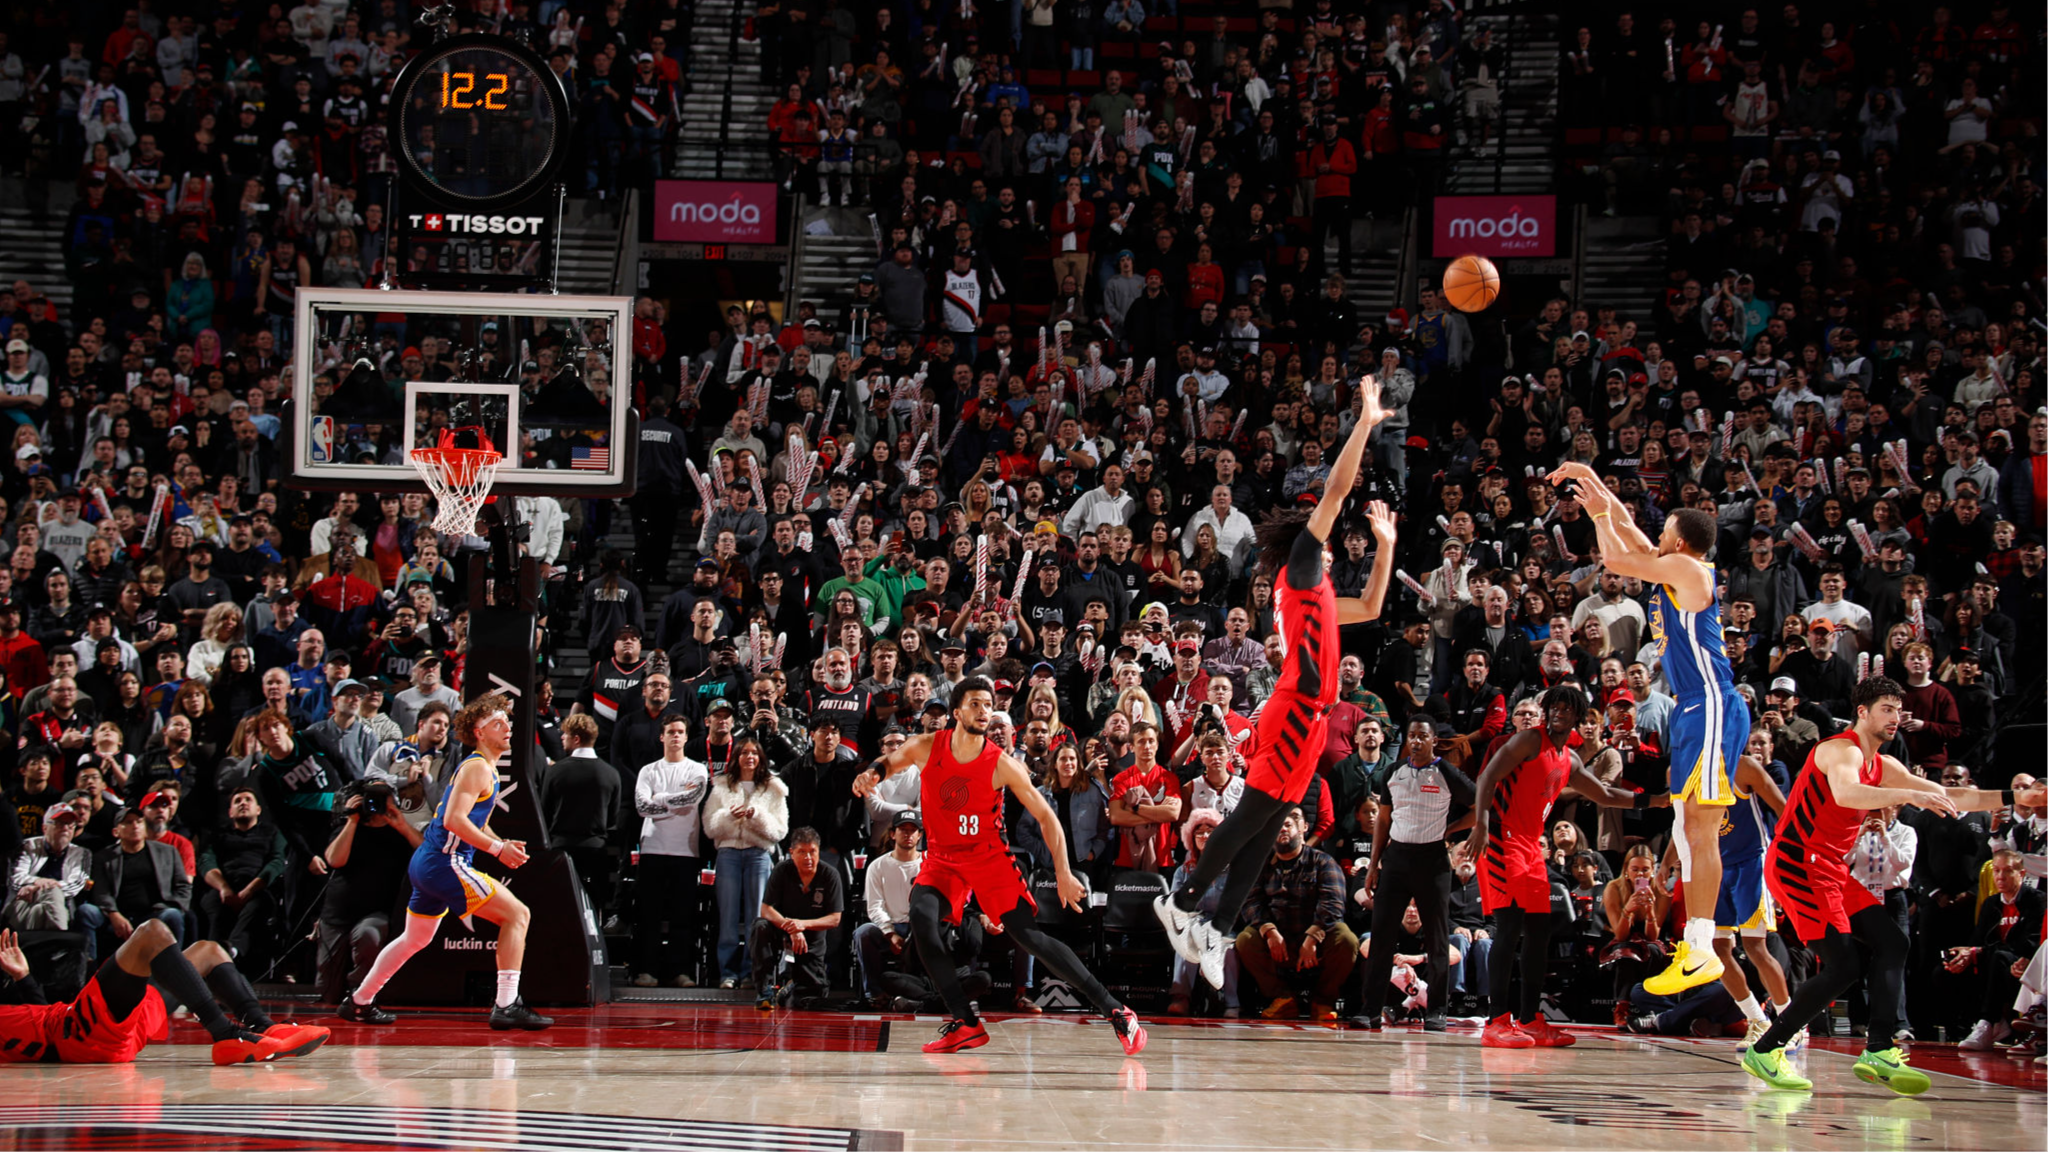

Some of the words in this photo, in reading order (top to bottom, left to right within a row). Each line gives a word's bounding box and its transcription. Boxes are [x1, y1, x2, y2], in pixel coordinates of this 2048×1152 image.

[442, 71, 508, 110] 12.2
[671, 198, 760, 223] moda
[445, 214, 543, 235] TISSOT
[723, 227, 760, 235] HEALTH
[1449, 213, 1538, 238] moda
[1500, 241, 1538, 249] HEALTH
[641, 429, 672, 444] SECURITY
[49, 534, 83, 546] BLAZERS
[818, 699, 859, 712] PORTLAND
[283, 754, 322, 792] PDX
[958, 814, 979, 836] 33
[1114, 883, 1162, 893] ticketmaster
[444, 937, 482, 950] luckin
